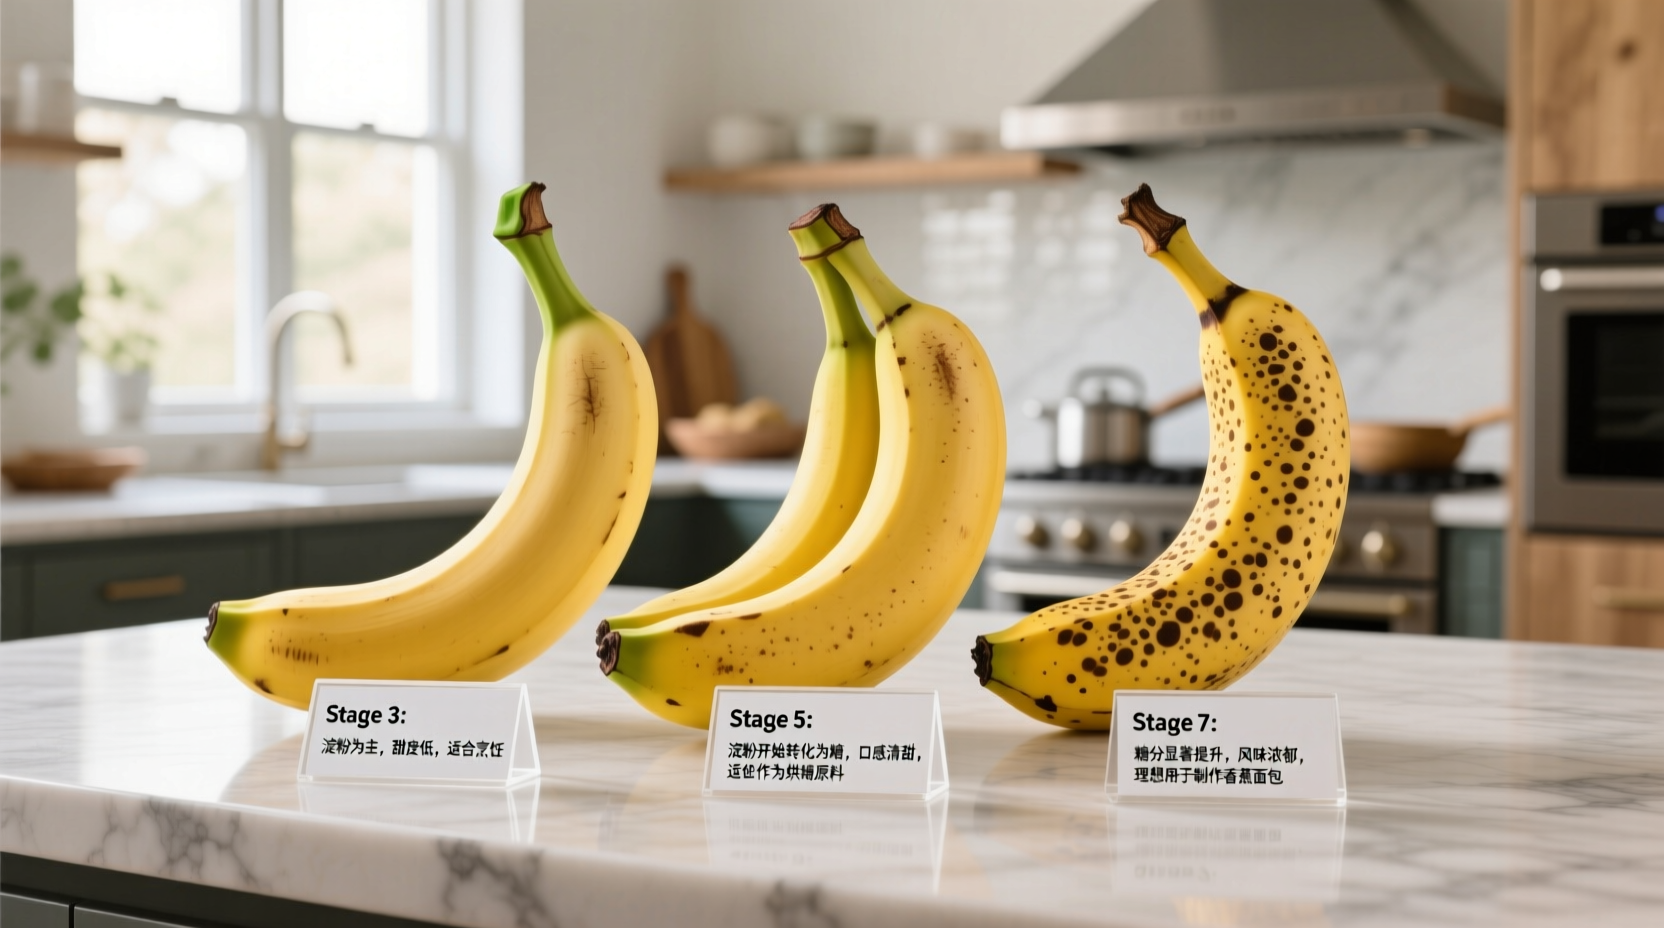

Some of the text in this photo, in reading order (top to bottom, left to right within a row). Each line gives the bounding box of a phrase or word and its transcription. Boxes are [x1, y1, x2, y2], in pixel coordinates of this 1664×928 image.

[325, 704, 407, 729] Stage 3:
[729, 708, 813, 733] Stage 5:
[1132, 711, 1217, 737] Stage 7:
